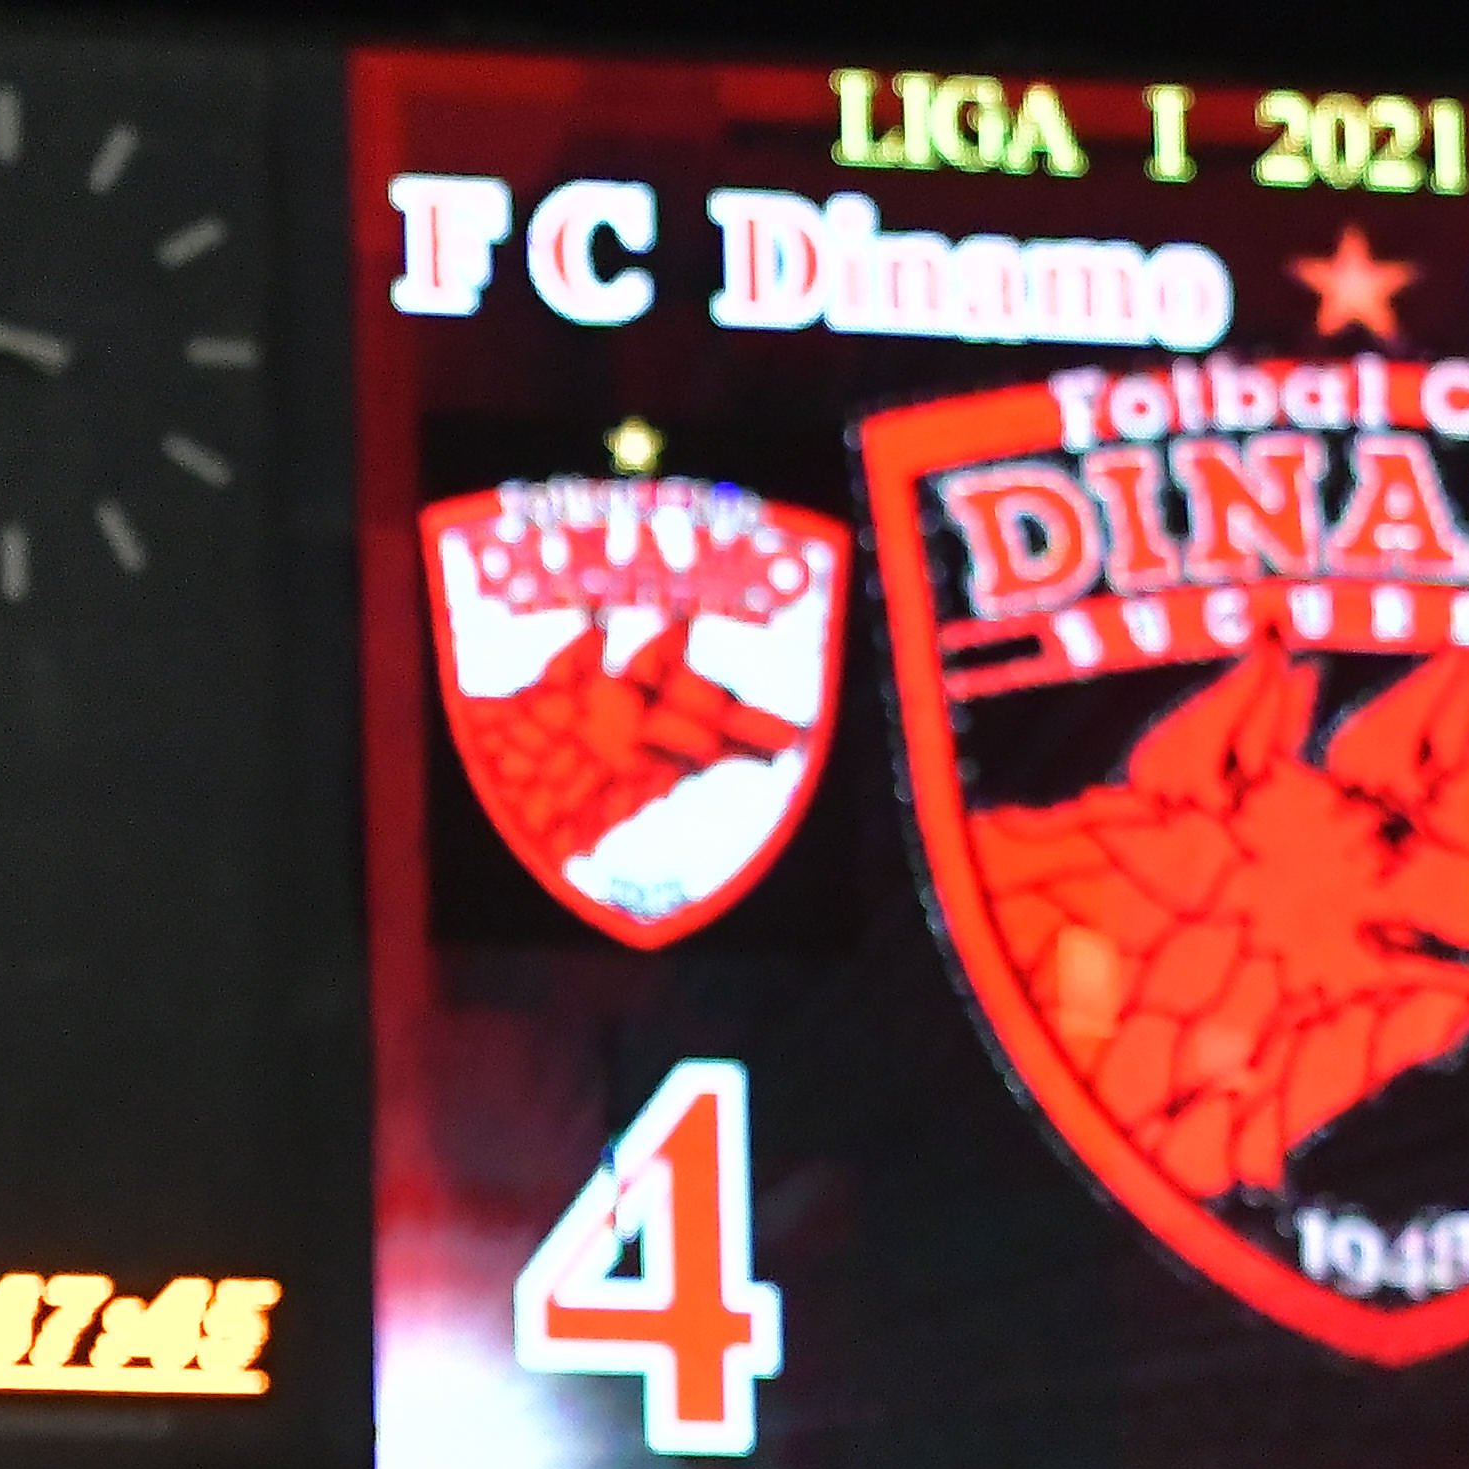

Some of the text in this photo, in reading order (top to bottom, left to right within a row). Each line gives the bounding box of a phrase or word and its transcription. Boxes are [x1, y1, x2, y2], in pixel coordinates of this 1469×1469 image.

[829, 66, 1089, 178] LIGA
[389, 172, 1234, 352] F C Dinamo
[512, 1056, 785, 1457] 4
